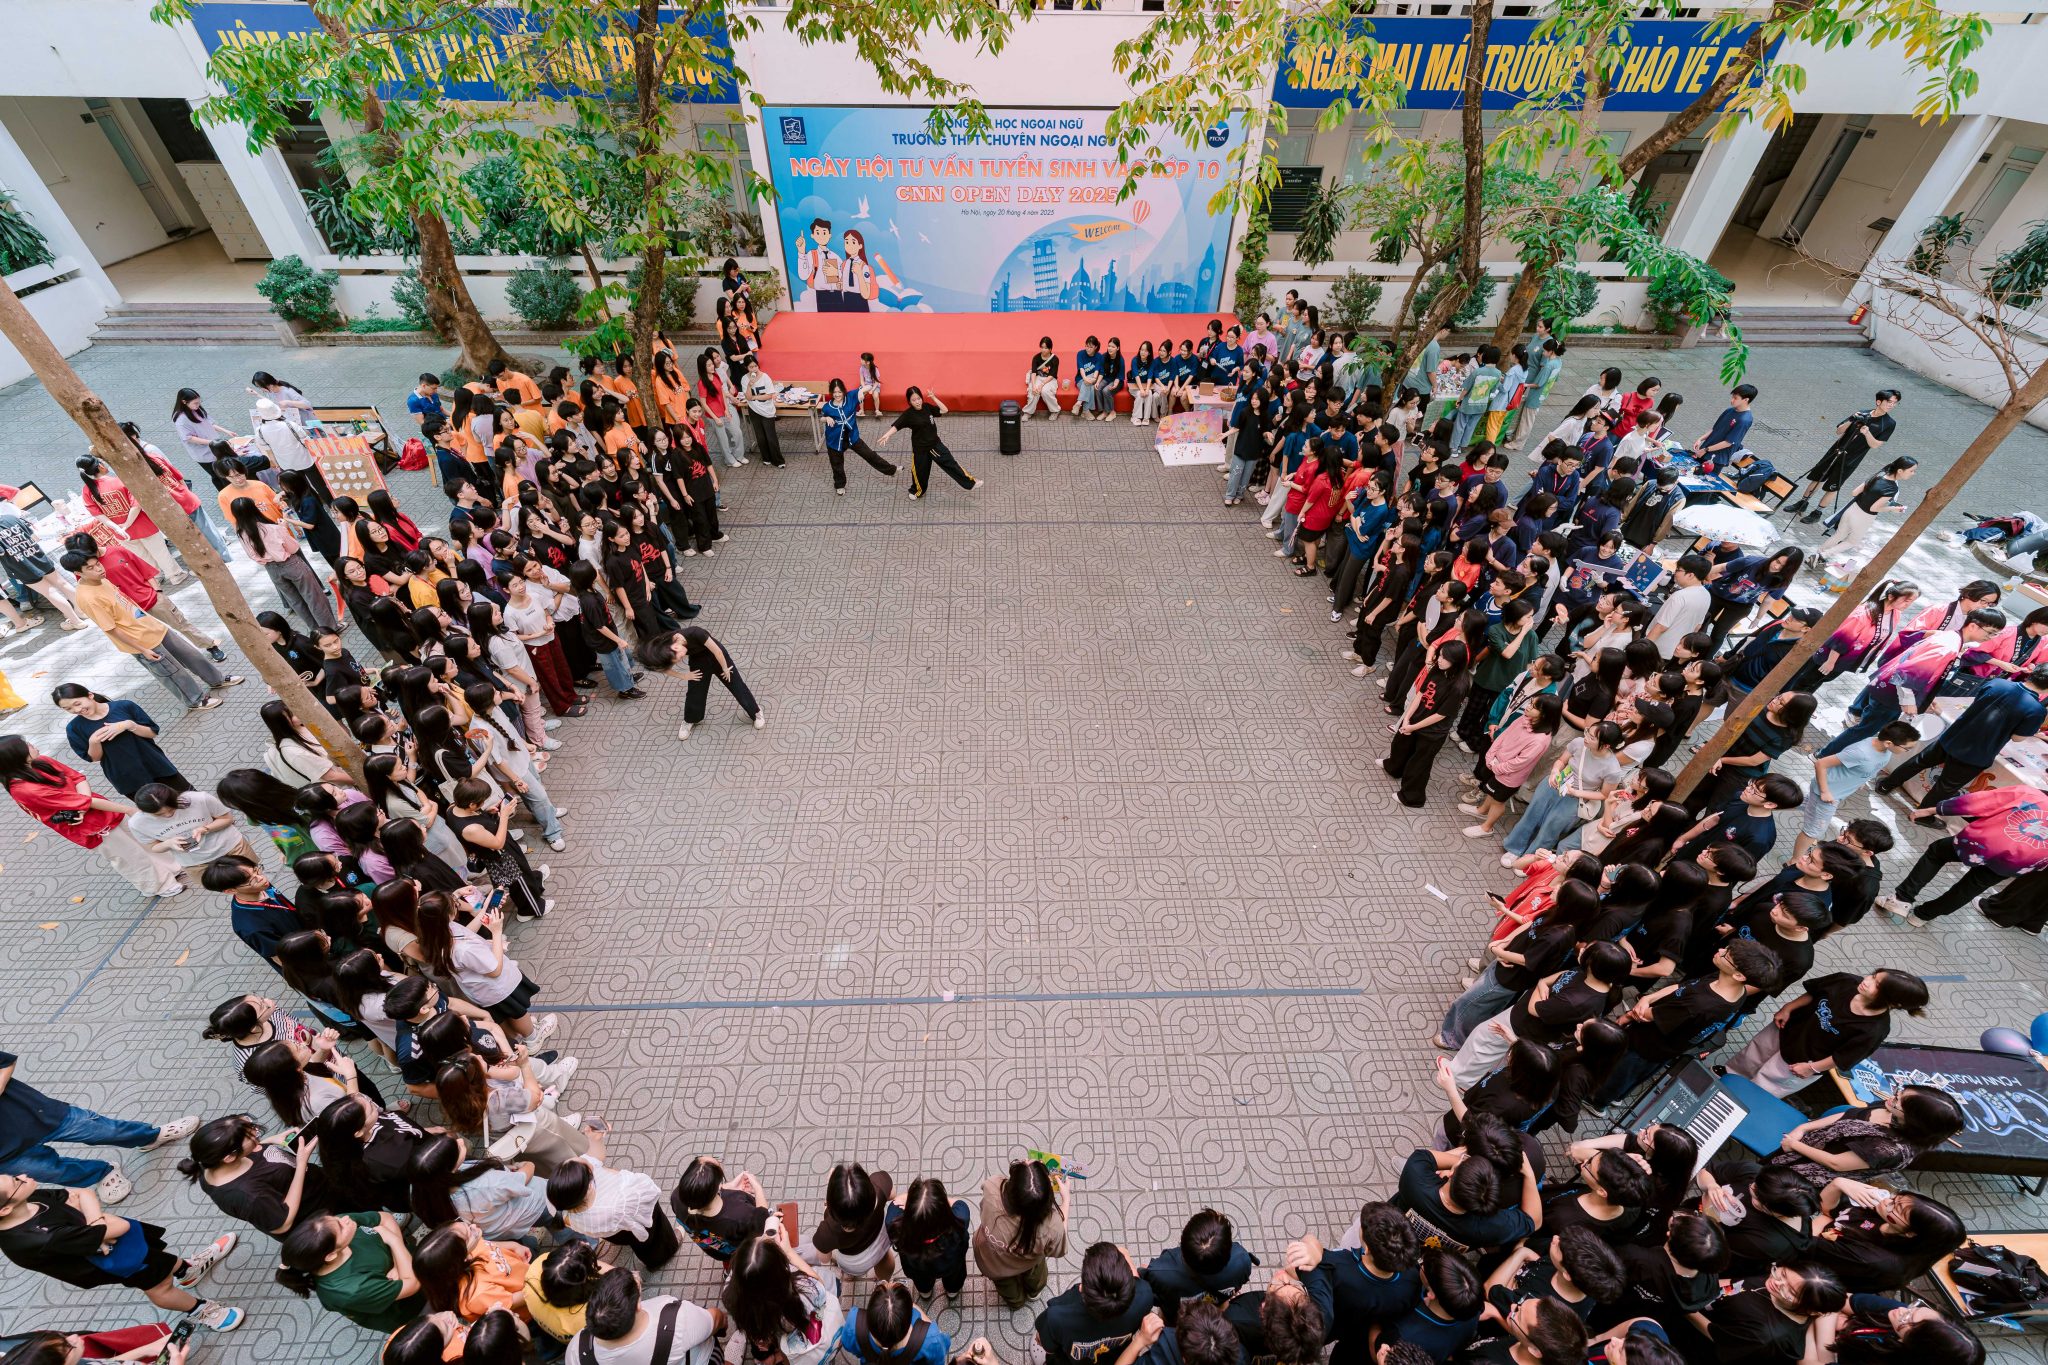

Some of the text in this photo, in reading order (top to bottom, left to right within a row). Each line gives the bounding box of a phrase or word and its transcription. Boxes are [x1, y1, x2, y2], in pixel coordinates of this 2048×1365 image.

[1420, 33, 1476, 91] MÁ
[995, 118, 1018, 131] HỌC
[1021, 119, 1056, 131] NGOẠI
[1060, 117, 1084, 130] NGỮ
[892, 130, 947, 146] TRƯỜNG
[987, 131, 1036, 146] CHUYÊN
[1040, 134, 1083, 149] NGOẠI
[789, 152, 850, 177] NGÀY
[856, 153, 894, 183] HỘI
[898, 157, 924, 178] TƯ
[929, 152, 973, 178] VẤN
[979, 152, 1043, 178] TUYỂN
[1049, 160, 1097, 178] SINH
[1198, 160, 1221, 180] 10
[895, 185, 1119, 204] CNN OPEN DAY 2025
[1084, 224, 1121, 239] WELCOME
